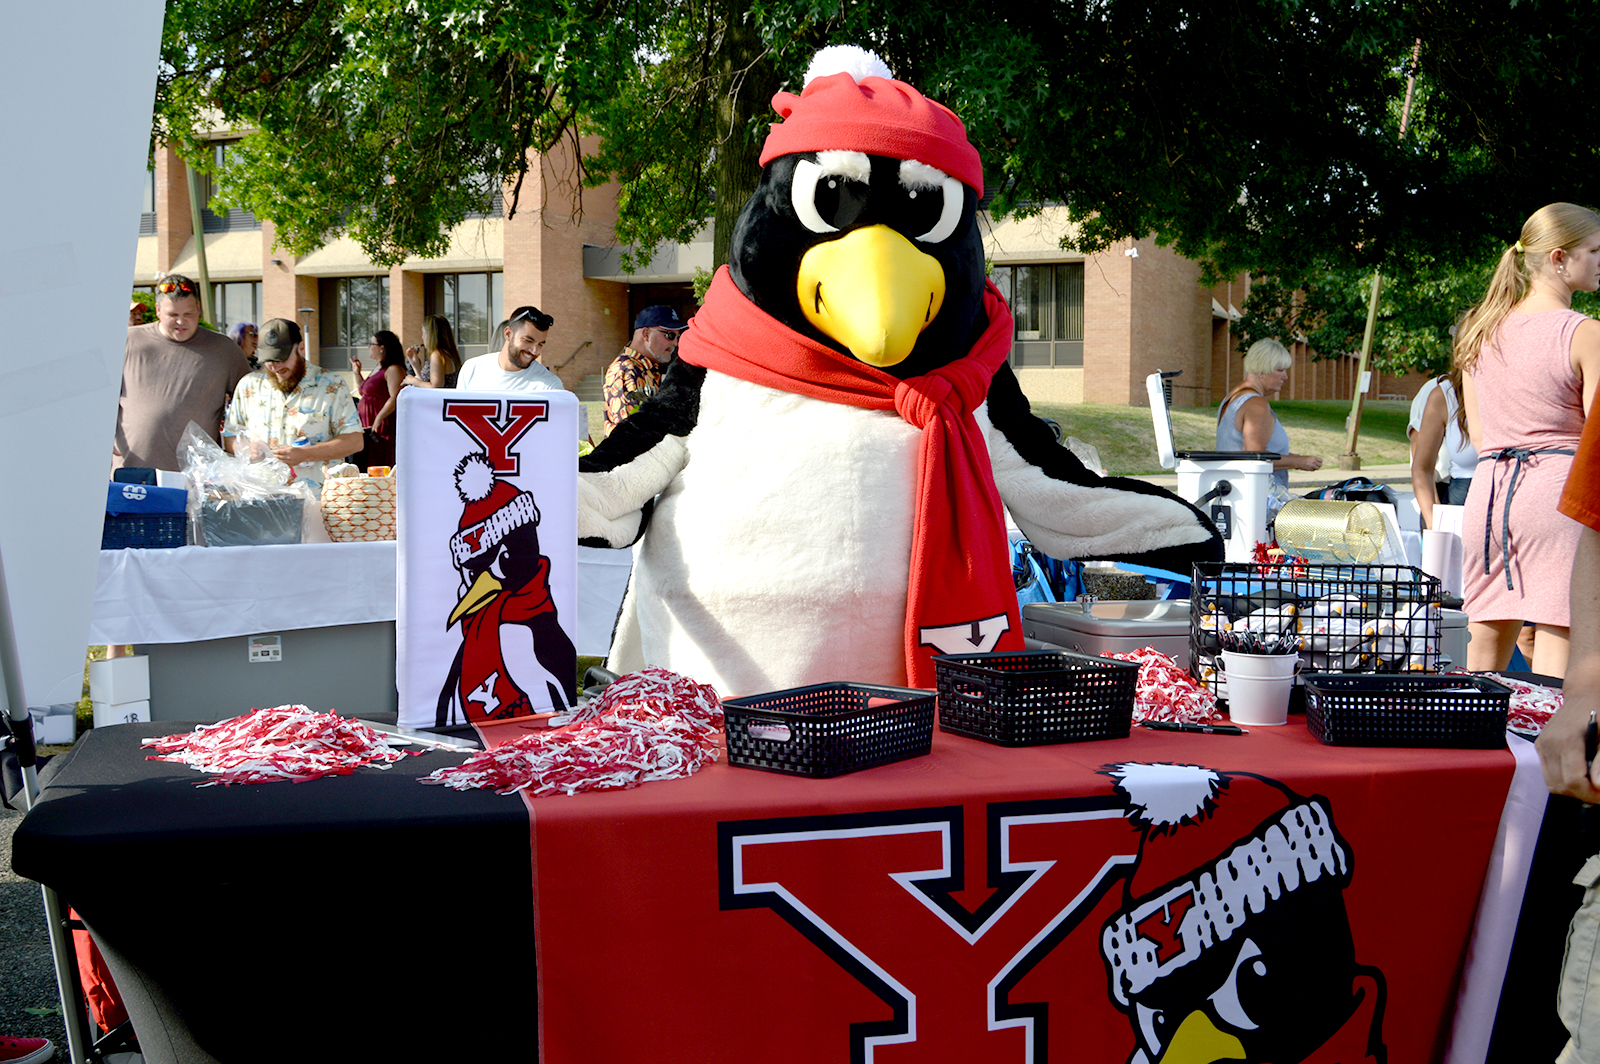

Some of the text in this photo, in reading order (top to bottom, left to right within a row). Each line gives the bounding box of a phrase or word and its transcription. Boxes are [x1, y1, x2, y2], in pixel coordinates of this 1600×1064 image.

[443, 399, 549, 476] Y
[462, 525, 485, 554] Y
[466, 669, 502, 716] Y
[717, 795, 1139, 1064] Y
[1134, 888, 1196, 968] Y
